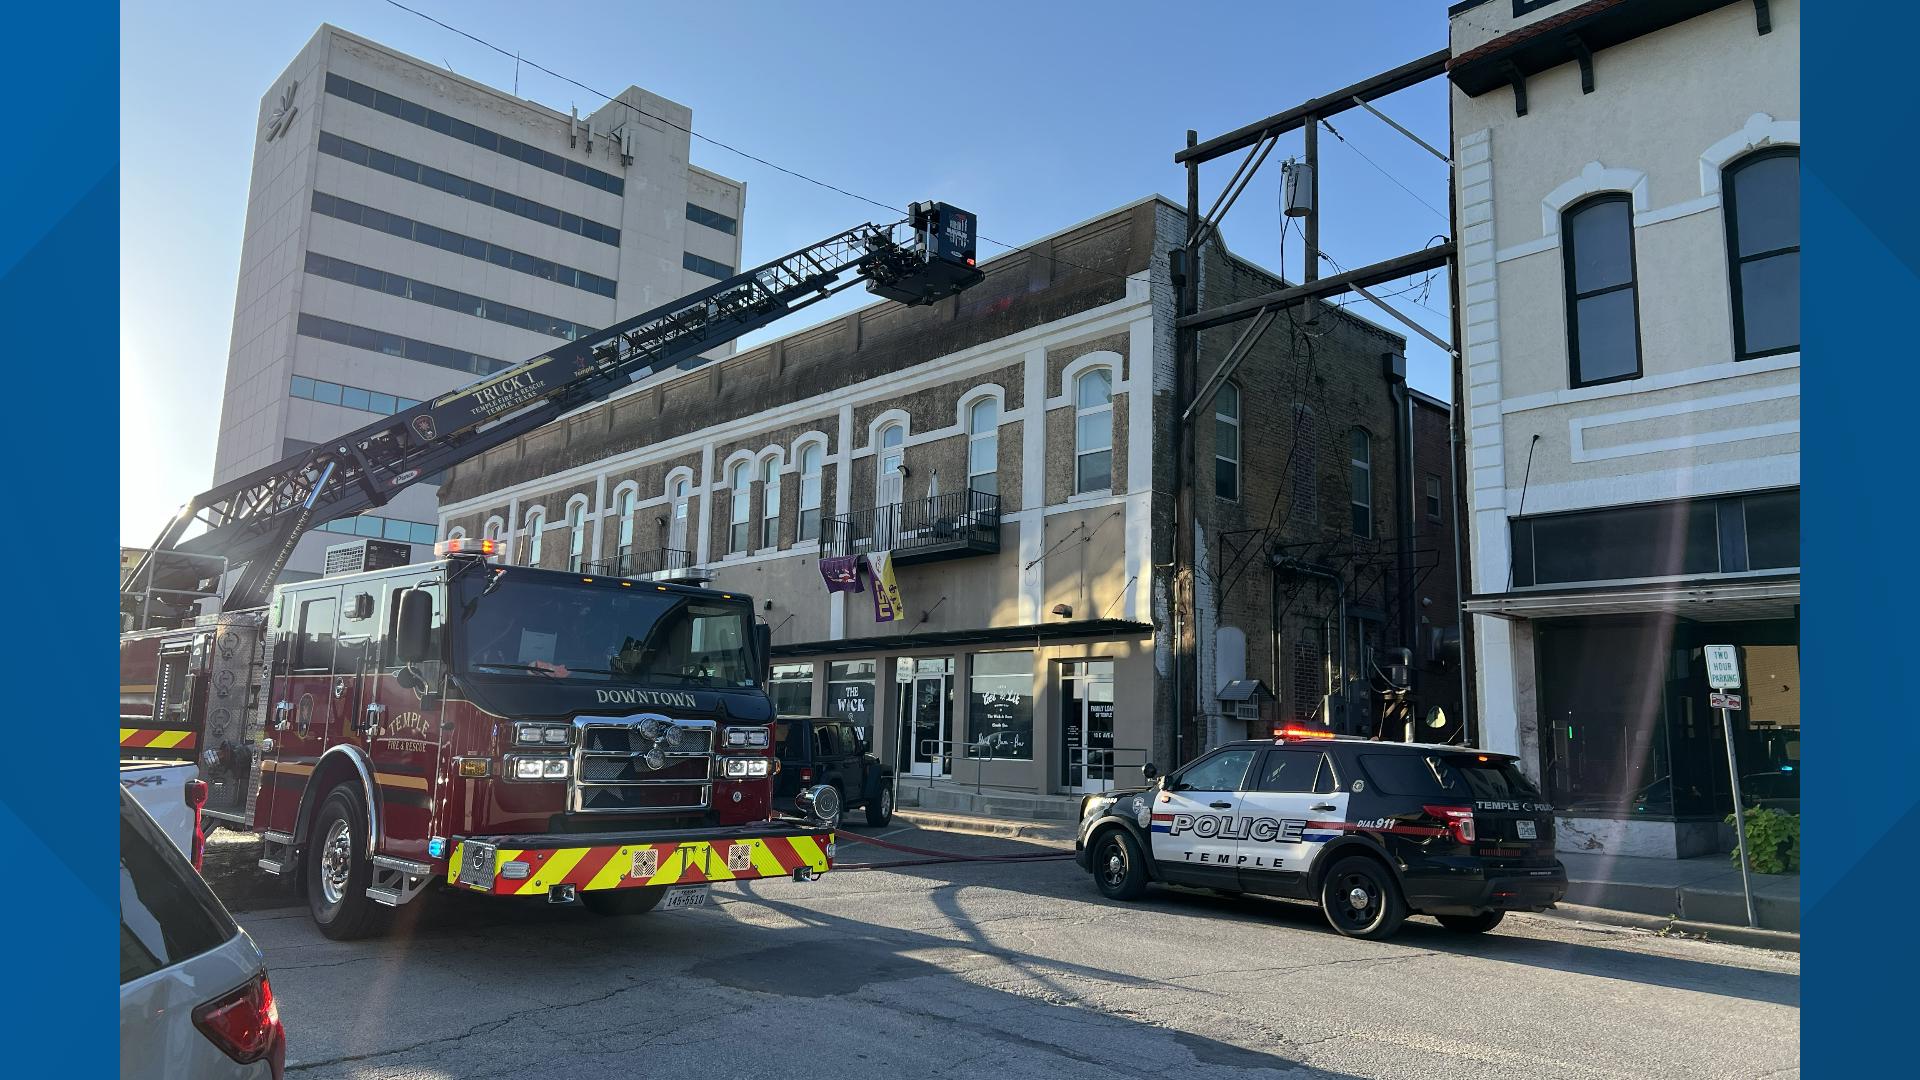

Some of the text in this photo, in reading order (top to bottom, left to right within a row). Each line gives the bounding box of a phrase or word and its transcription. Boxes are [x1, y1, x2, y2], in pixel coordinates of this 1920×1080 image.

[472, 371, 535, 405] TRUCK 1
[471, 401, 499, 415] TEMPLE
[499, 393, 514, 404] FIRE
[520, 380, 546, 395] RESCUE
[513, 390, 538, 404] TEXAS
[259, 548, 288, 595] EXCELLENCE
[290, 510, 311, 542] SERVICE
[1714, 651, 1729, 660] TWO
[1713, 662, 1733, 671] HOUR
[1712, 673, 1738, 683] PARKING
[596, 689, 697, 708] DOWNTOWN
[846, 686, 859, 697] THE
[837, 698, 866, 712] WICK
[389, 711, 430, 739] TEMPLE
[387, 740, 399, 750] FIRE
[405, 741, 427, 752] RESCUE
[1476, 801, 1520, 811] TEMPLE
[1169, 814, 1308, 844] POLICE
[1356, 817, 1396, 830] DIAL 911
[1184, 851, 1284, 868] TEMPLE
